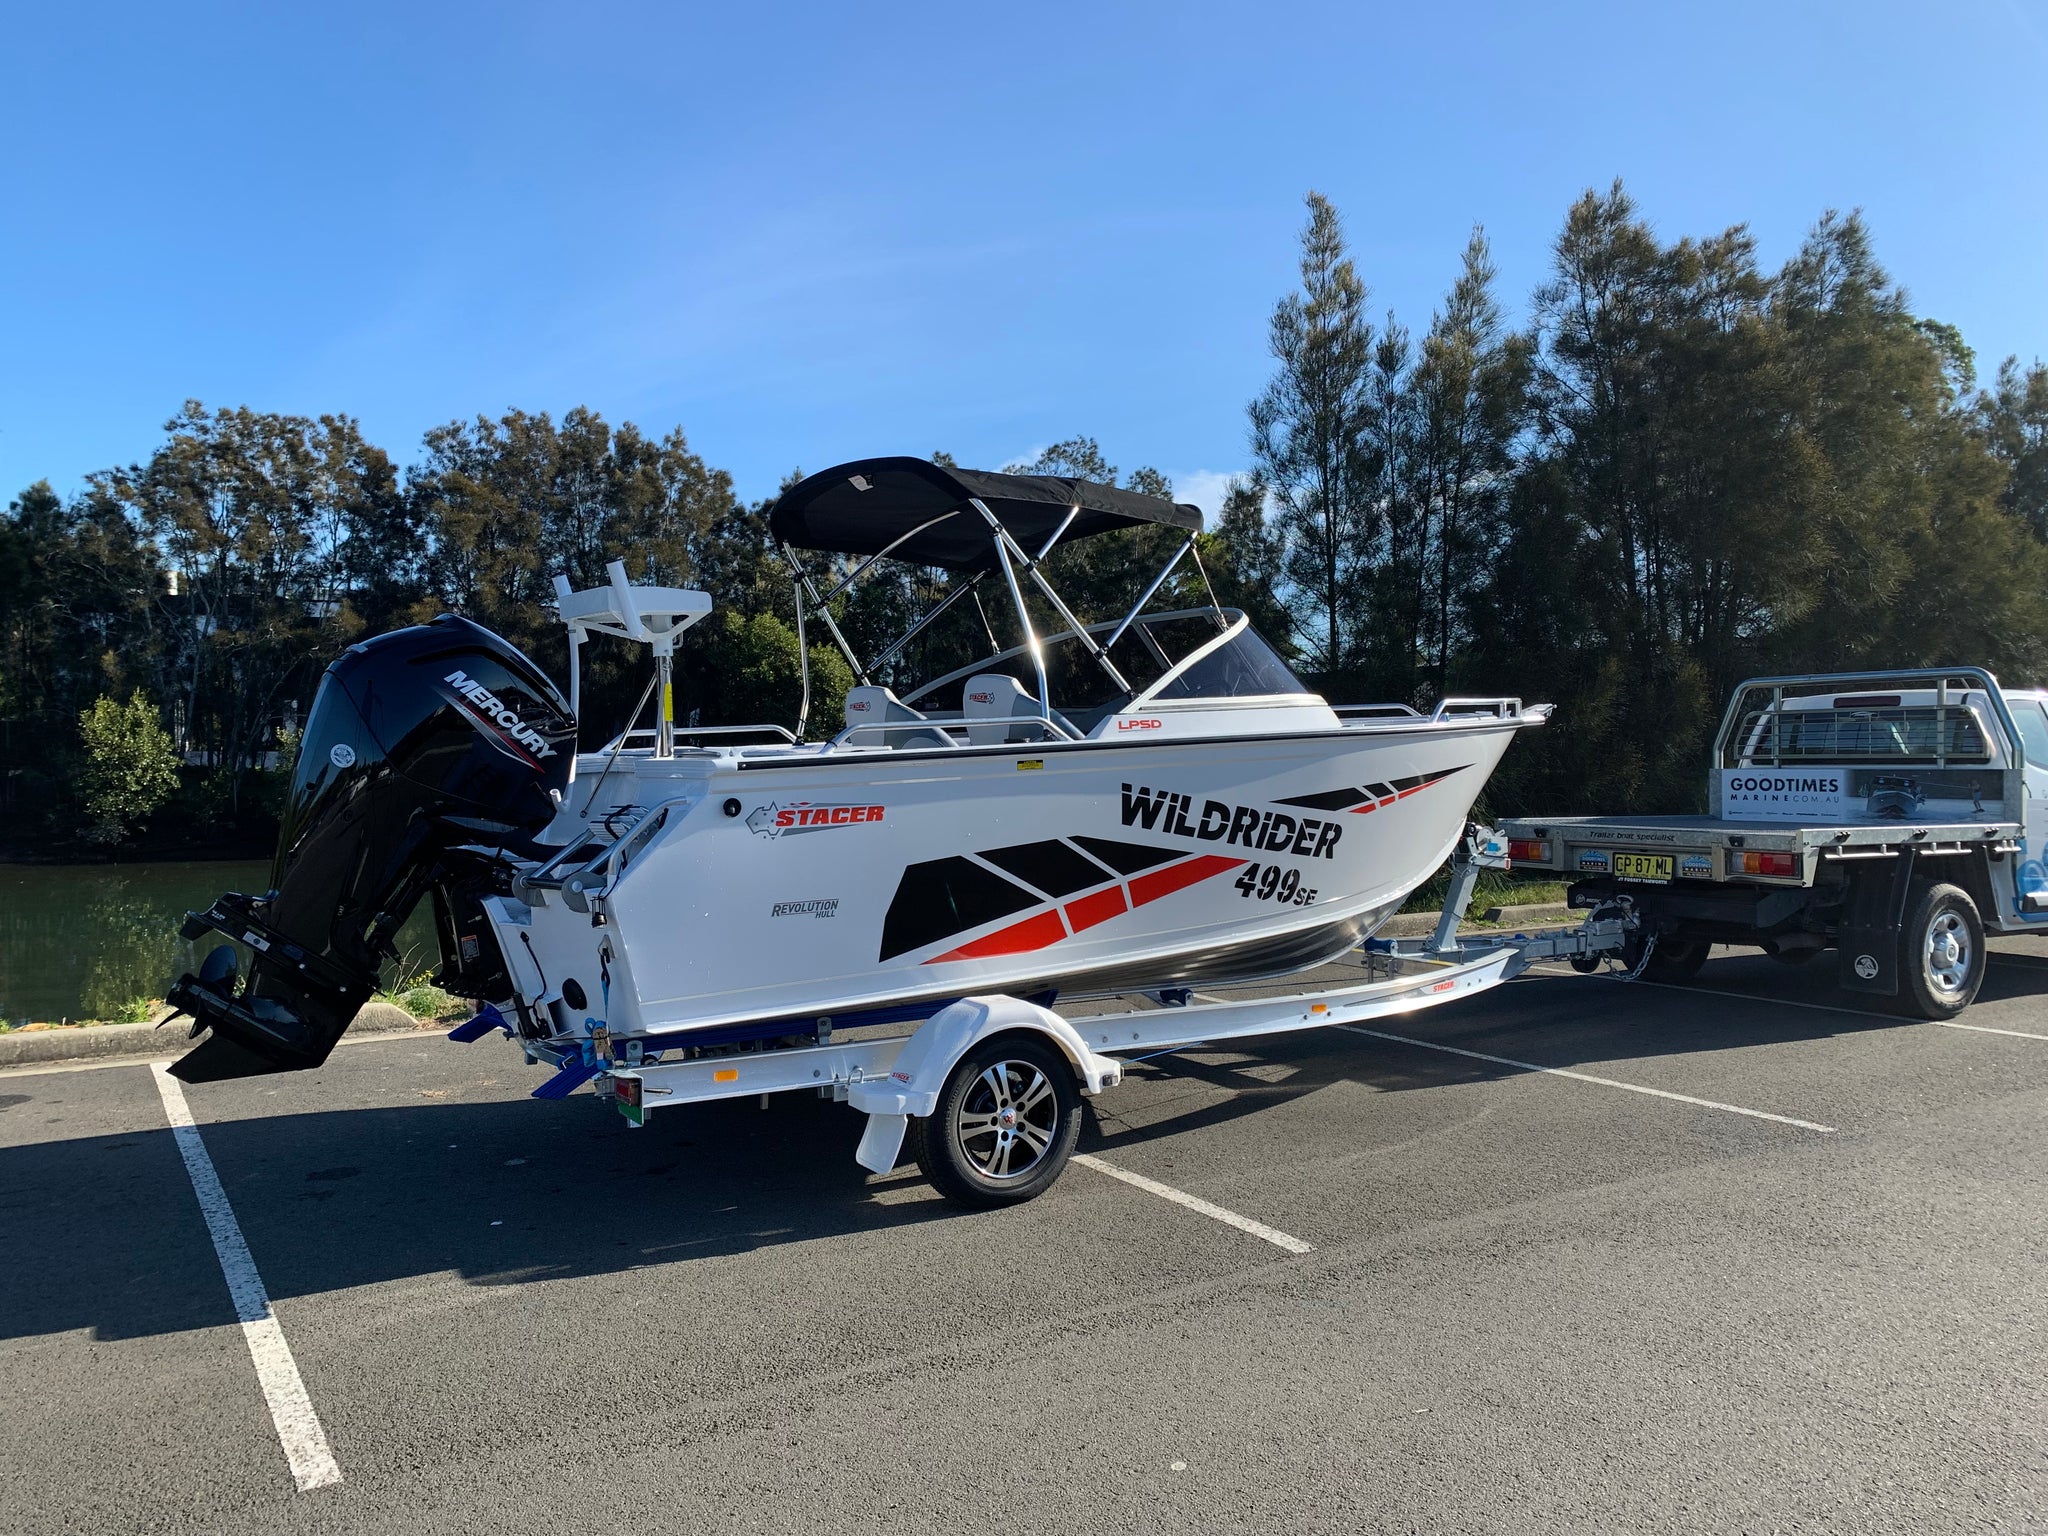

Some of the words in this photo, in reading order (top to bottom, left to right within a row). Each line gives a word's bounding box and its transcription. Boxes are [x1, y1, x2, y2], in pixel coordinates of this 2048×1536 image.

[443, 670, 558, 759] MERCURY
[1118, 720, 1163, 730] LPSD
[1730, 777, 1839, 793] GOODTIMES
[775, 805, 885, 828] STACER
[1121, 782, 1343, 859] WILDRIDER
[1590, 831, 1615, 839] Trailer
[1616, 832, 1634, 840] boat
[1635, 833, 1676, 842] specialist
[771, 900, 839, 917] REVOLUTION
[814, 910, 836, 919] HULL
